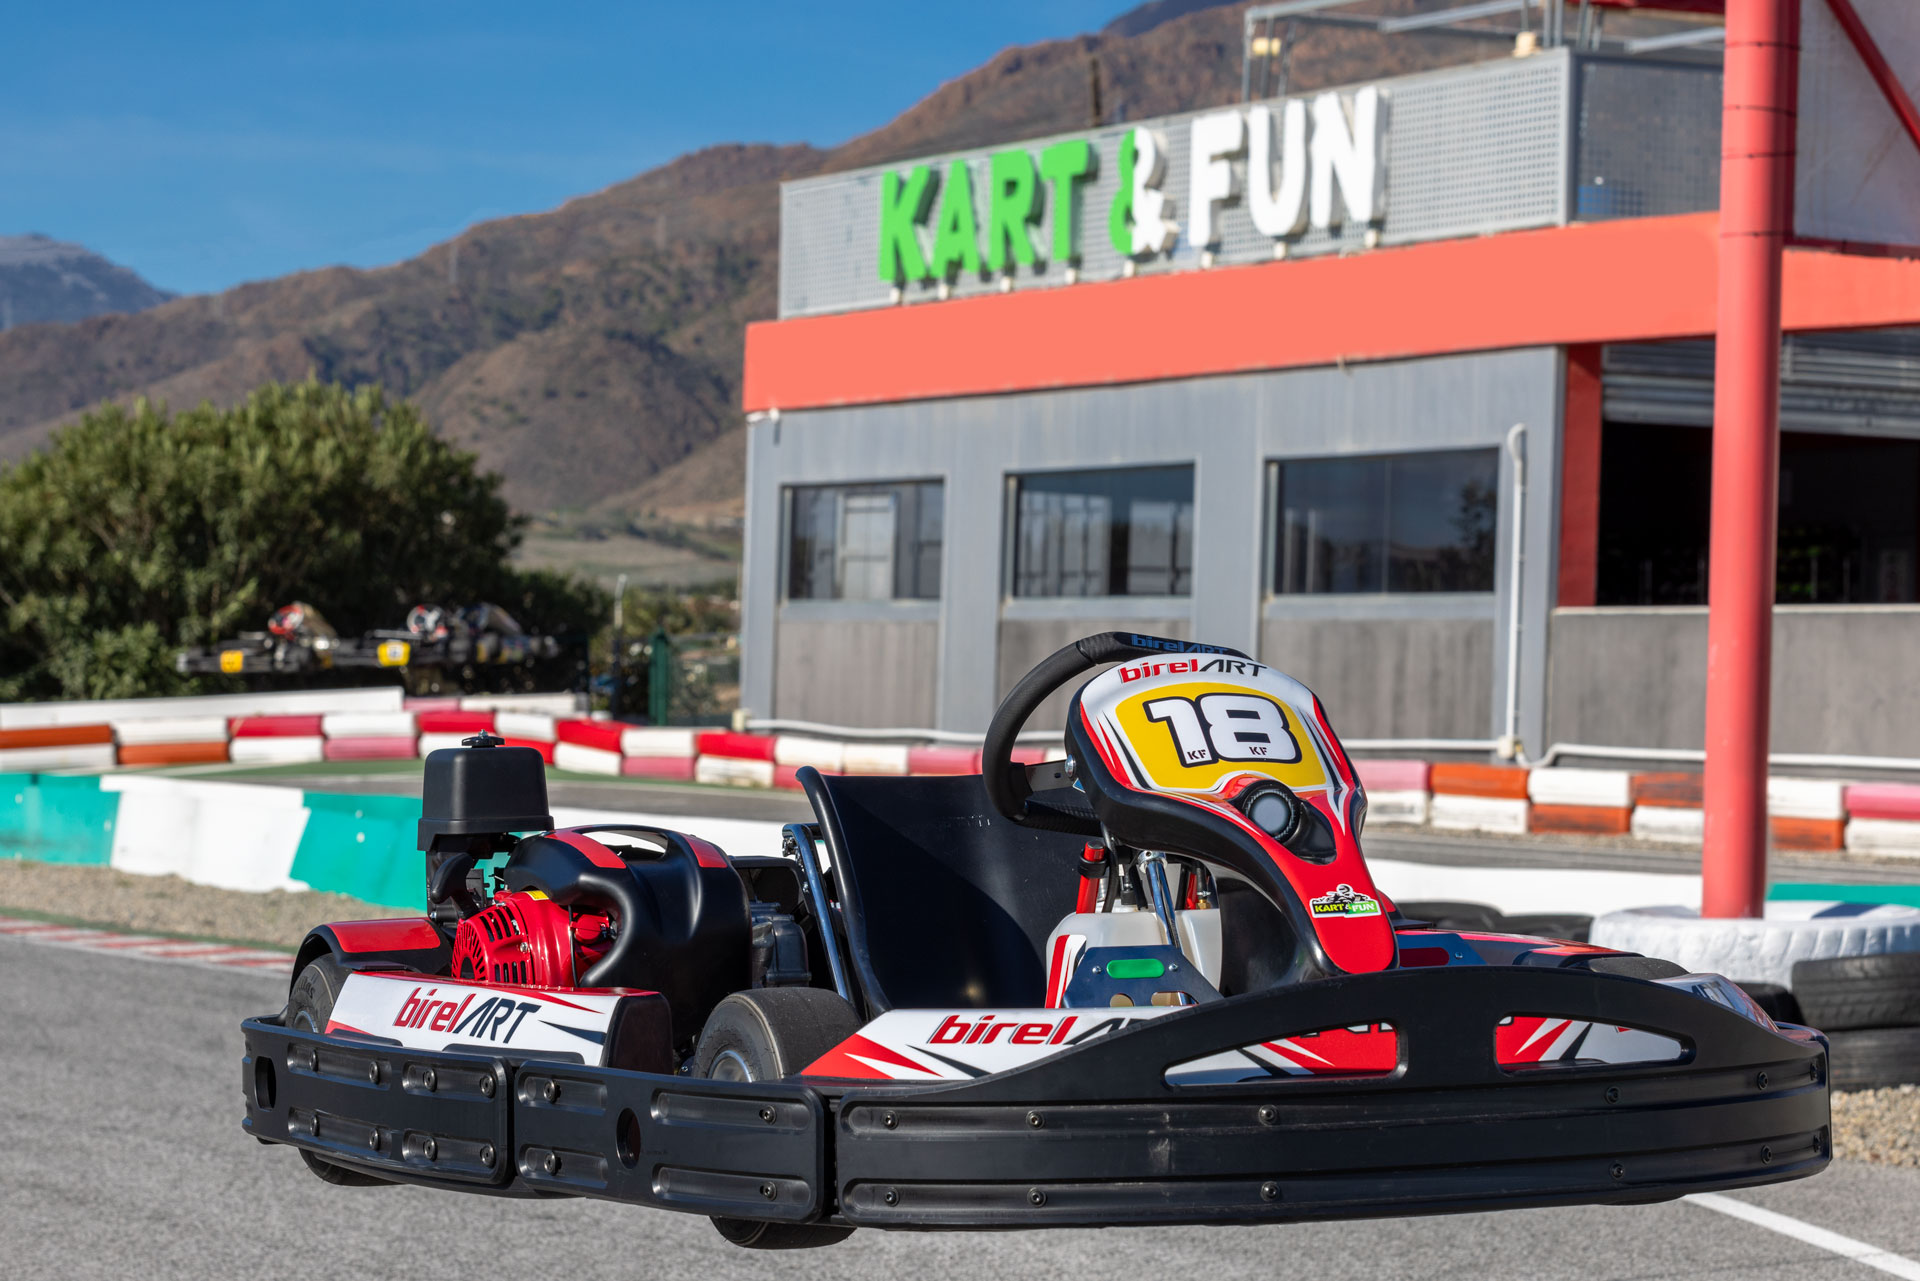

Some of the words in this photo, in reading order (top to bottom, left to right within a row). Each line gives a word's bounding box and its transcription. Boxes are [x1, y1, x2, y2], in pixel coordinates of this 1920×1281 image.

[878, 139, 1090, 281] KART
[1108, 126, 1170, 255] &
[1188, 85, 1380, 248] FUN
[1118, 658, 1268, 684] birelART
[1143, 692, 1302, 768] 18
[1187, 749, 1207, 760] KF
[1249, 746, 1268, 756] KF
[393, 986, 542, 1044] birelART
[926, 1014, 1150, 1045] birelA
